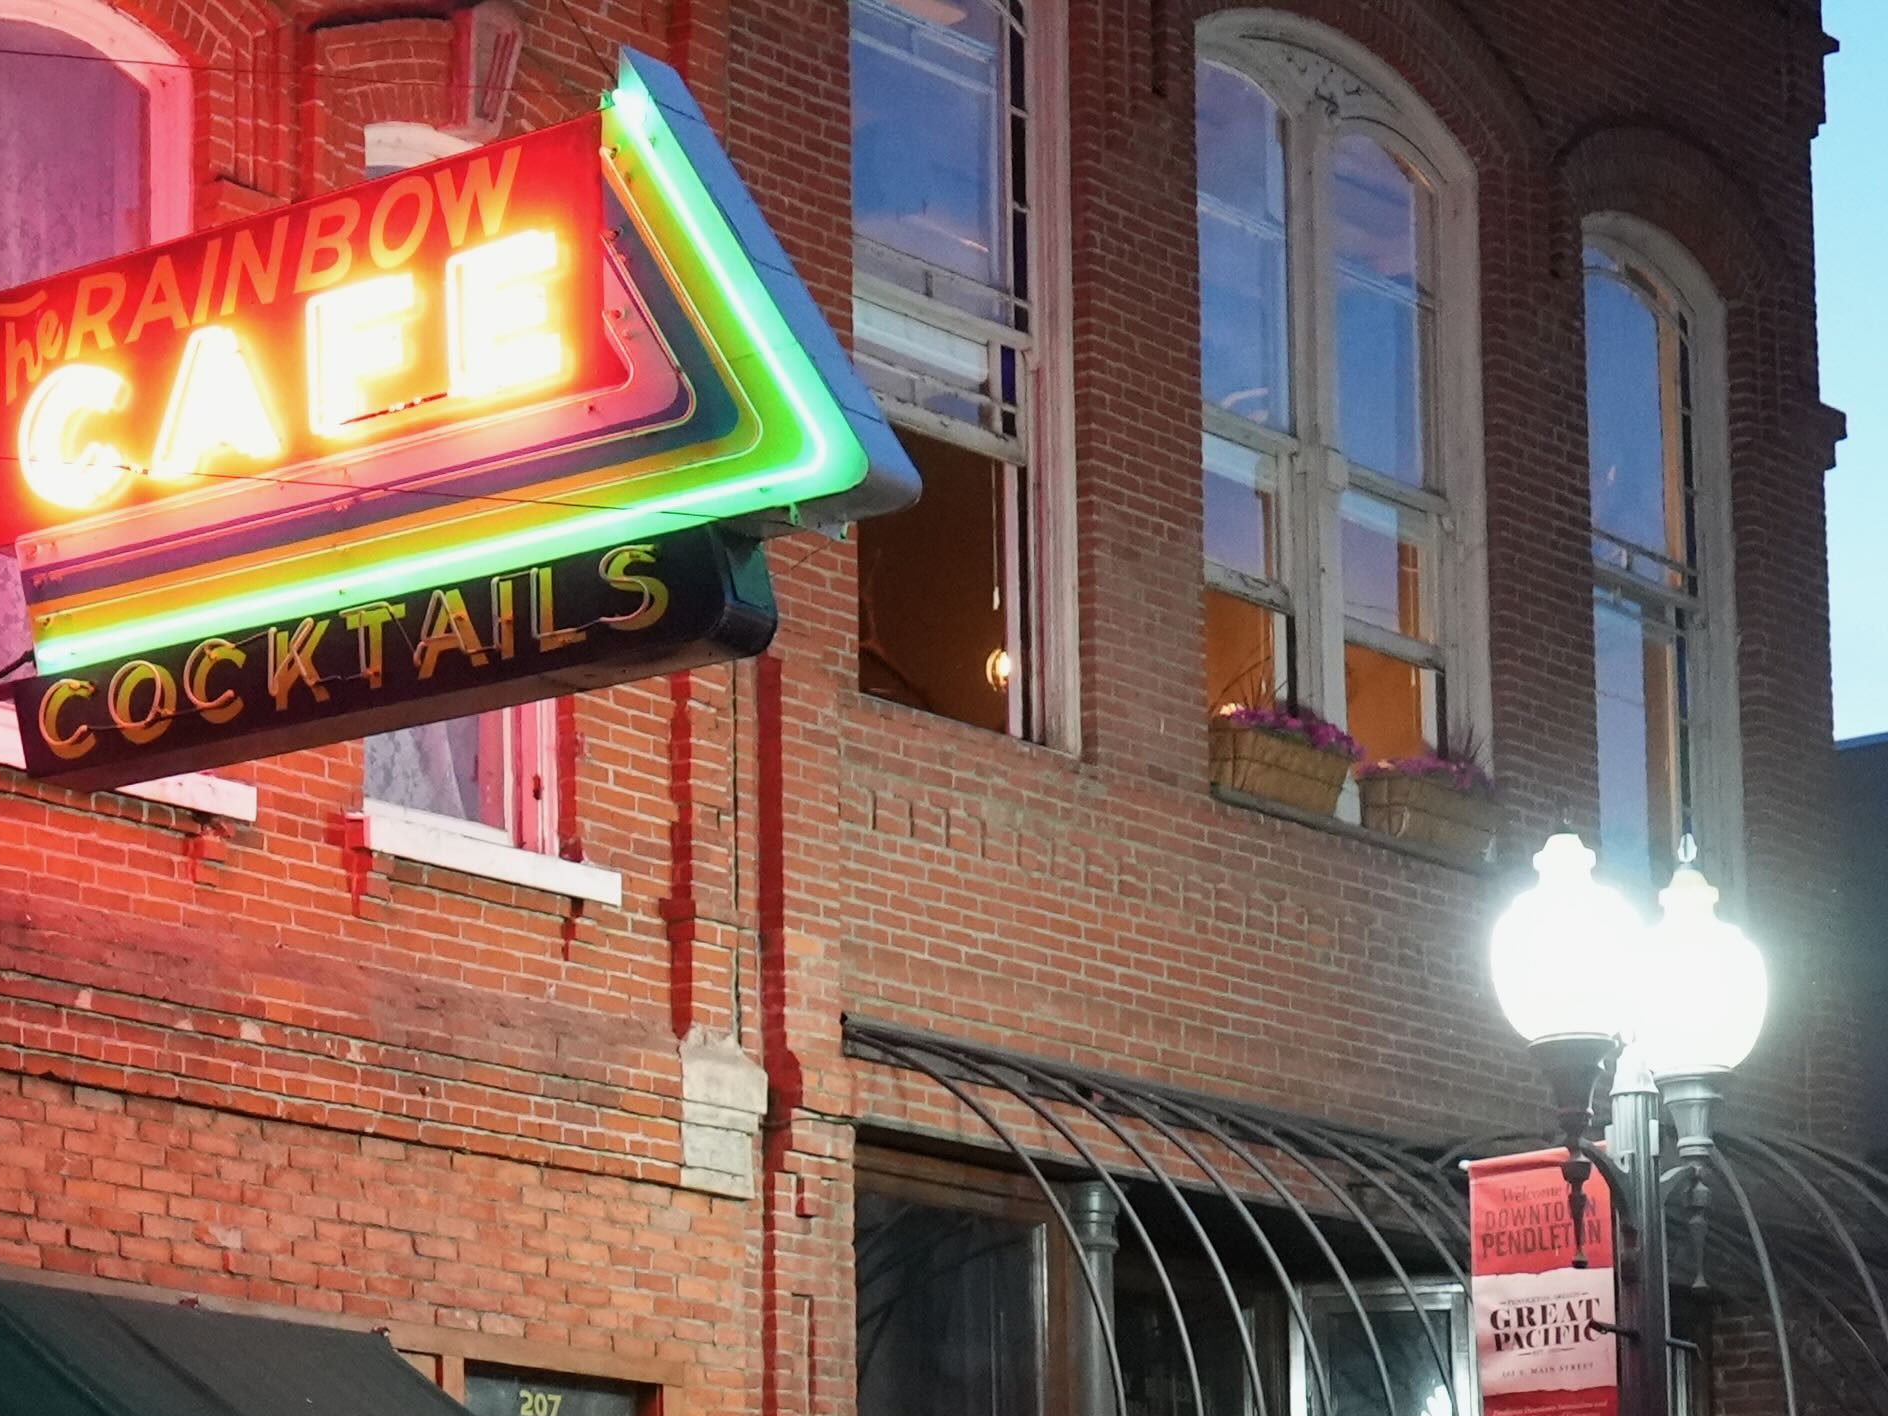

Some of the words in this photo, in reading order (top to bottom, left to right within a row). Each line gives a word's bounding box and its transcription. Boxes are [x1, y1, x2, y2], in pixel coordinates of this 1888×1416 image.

[65, 146, 523, 360] RAINBOW
[18, 229, 567, 510] CAFE
[39, 544, 669, 760] COCKTAILS
[1484, 1197, 1597, 1230] DOWNTON
[1481, 1220, 1602, 1259] PENDLETN
[1489, 1298, 1601, 1332] GREAT
[1493, 1323, 1600, 1352] PACIFIC
